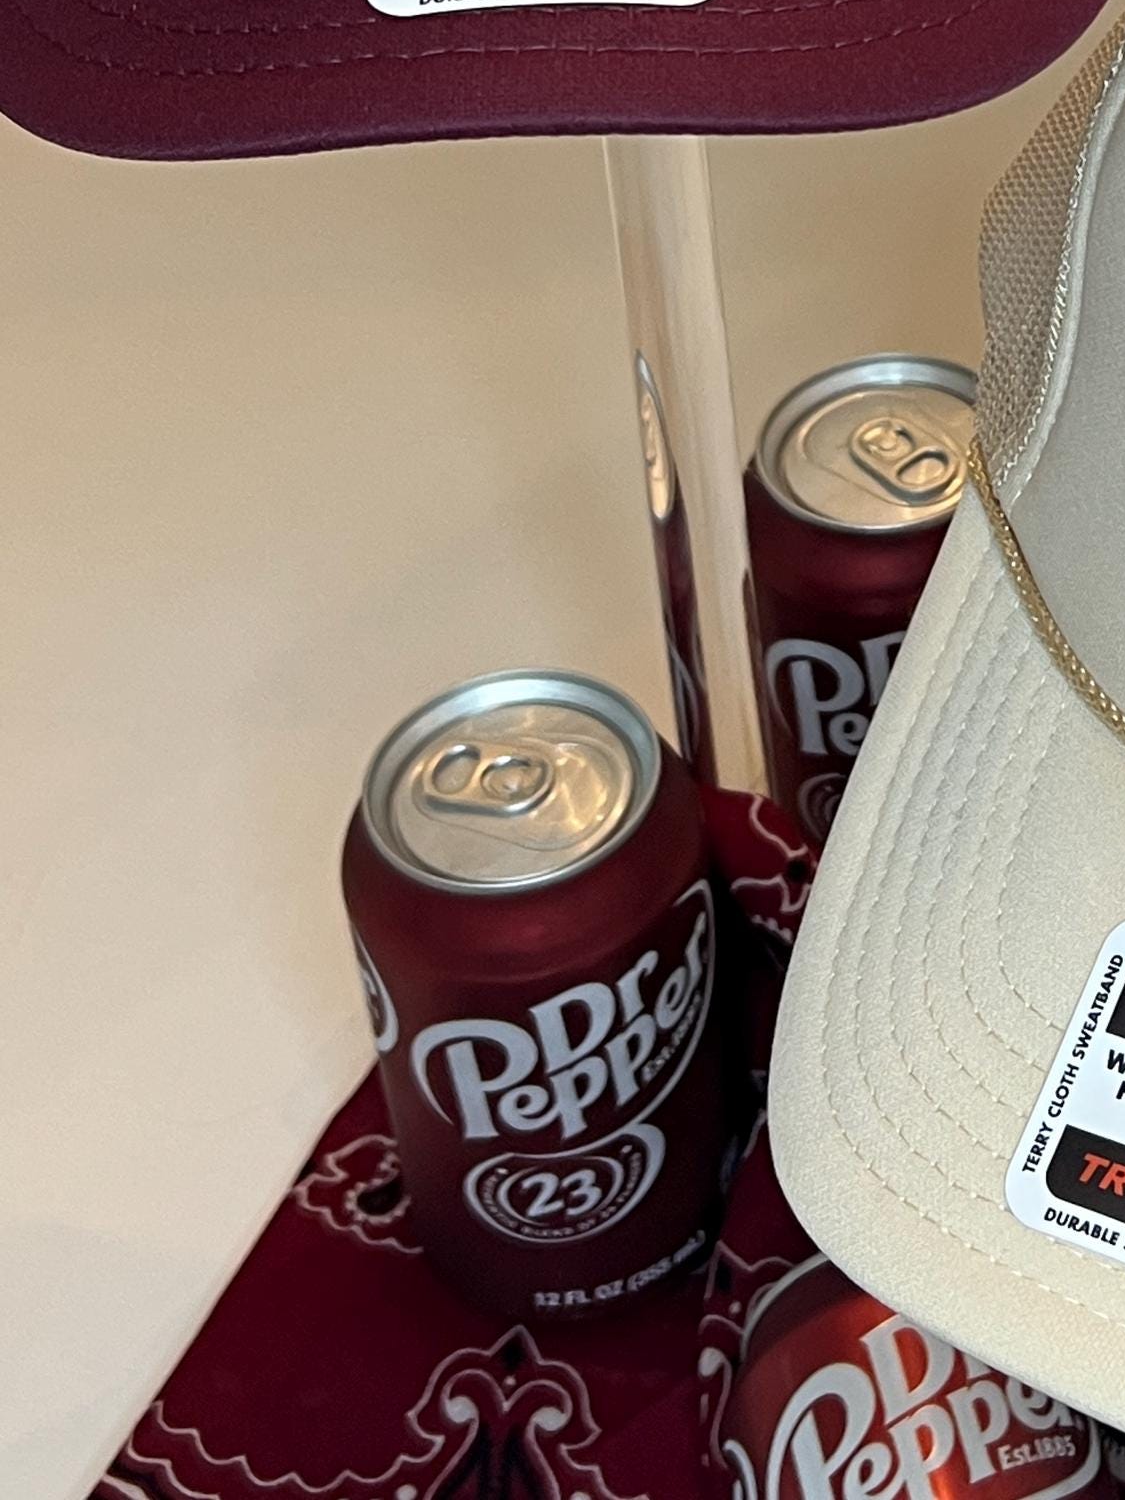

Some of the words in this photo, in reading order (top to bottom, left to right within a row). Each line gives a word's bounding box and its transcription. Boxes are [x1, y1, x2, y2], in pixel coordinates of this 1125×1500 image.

[410, 911, 708, 1141] Pepper
[528, 950, 660, 1075] Dr
[1021, 1120, 1054, 1174] TERRY
[1047, 1062, 1081, 1119] CLOTH
[1071, 953, 1125, 1060] SWEATBAND
[520, 1168, 603, 1218] 23
[1043, 1206, 1120, 1247] DURABLE
[534, 1292, 561, 1307] 12
[859, 1312, 994, 1432] D
